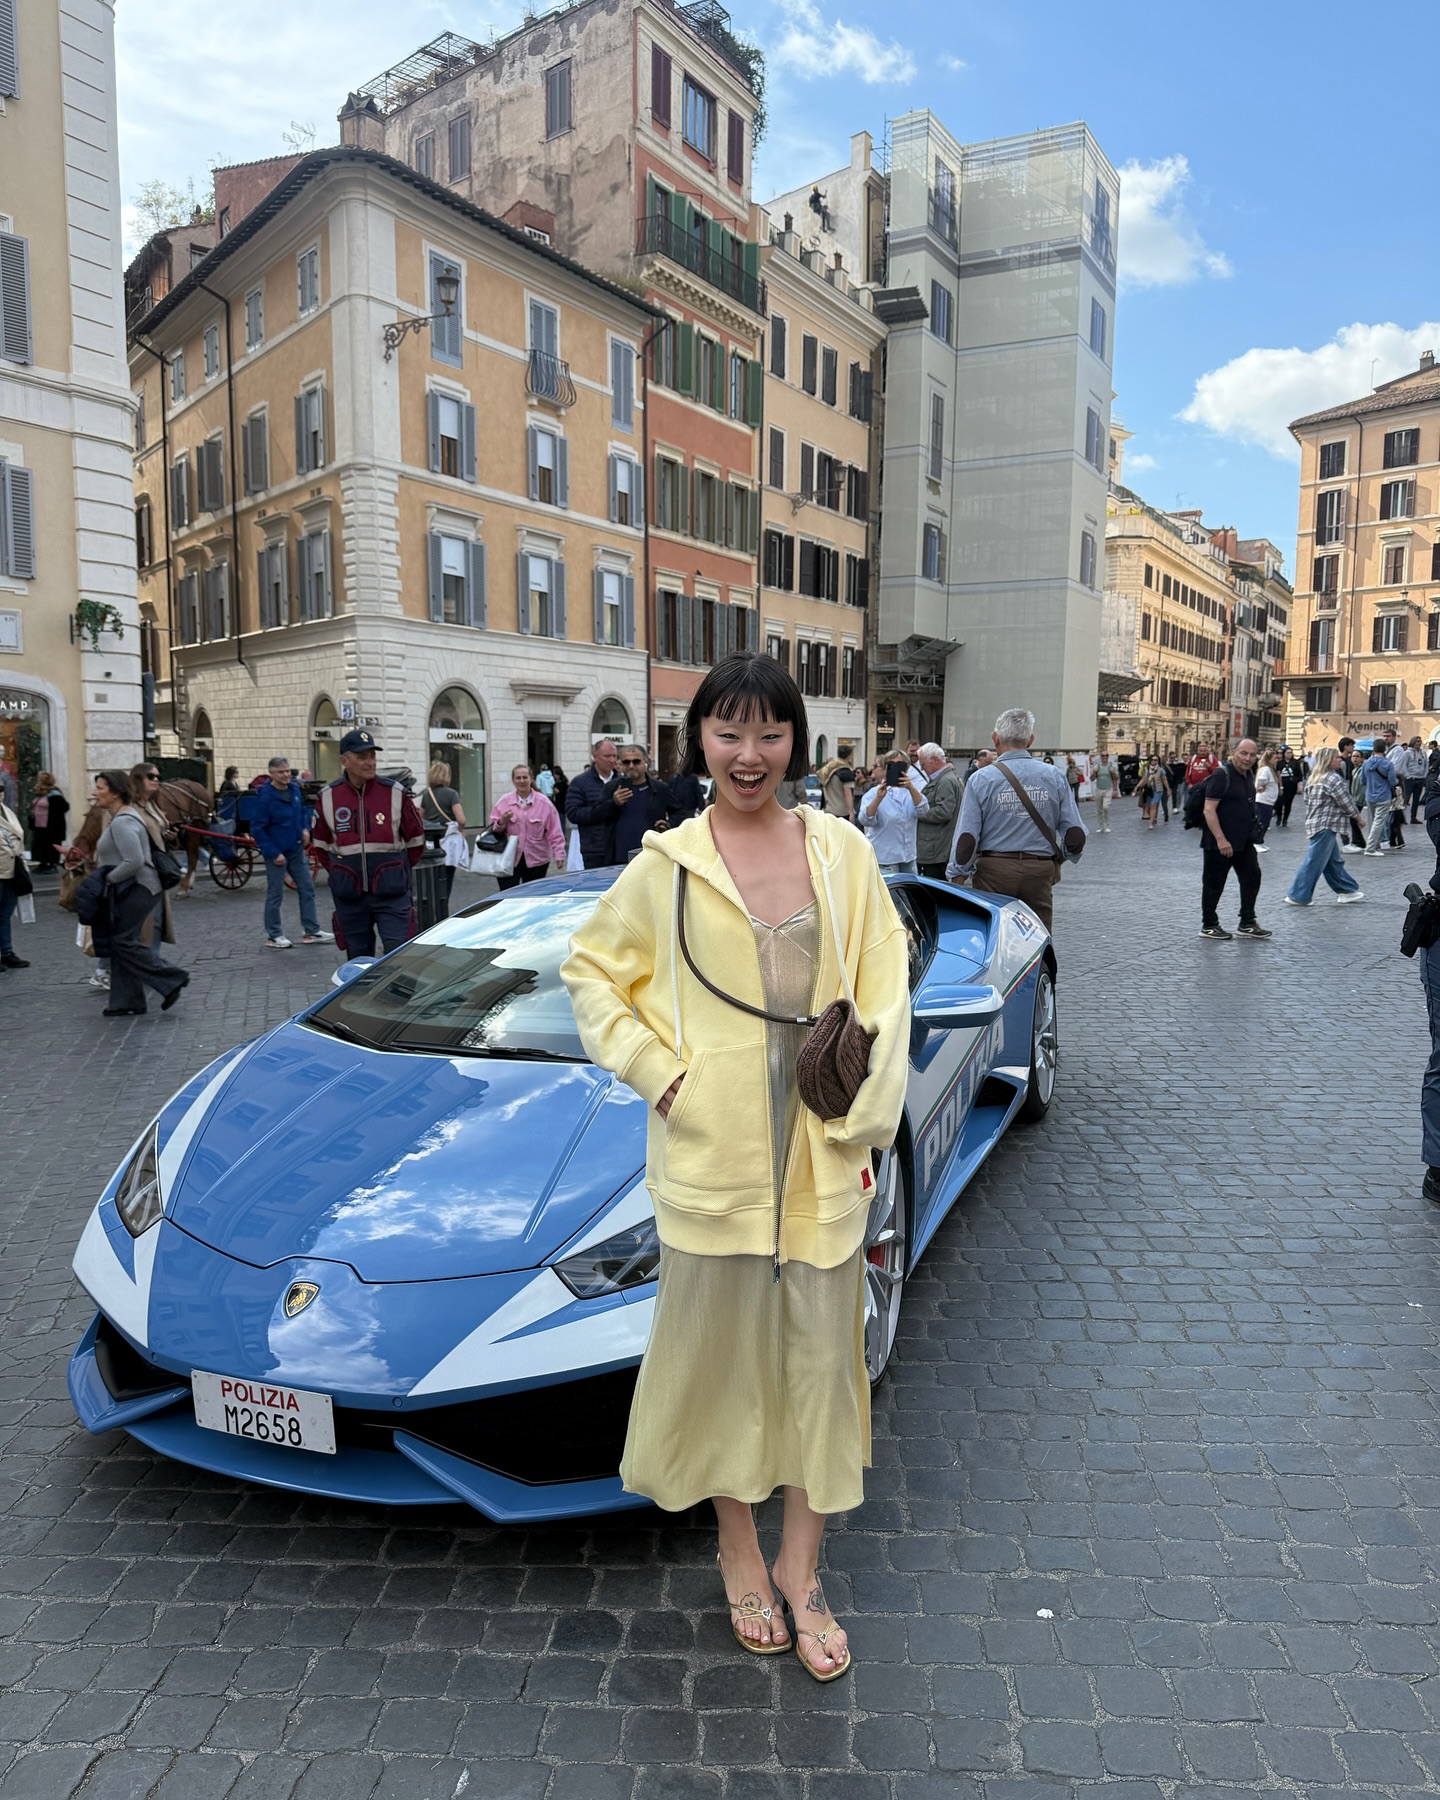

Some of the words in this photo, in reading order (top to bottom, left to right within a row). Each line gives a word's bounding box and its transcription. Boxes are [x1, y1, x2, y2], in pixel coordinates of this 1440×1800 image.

[446, 732, 474, 740] CHANEL
[1347, 720, 1398, 733] Menichini
[1011, 910, 1033, 936] 113
[923, 1014, 1005, 1191] POLIZIA
[220, 1379, 300, 1412] POLIZIA
[224, 1404, 302, 1446] M2658
